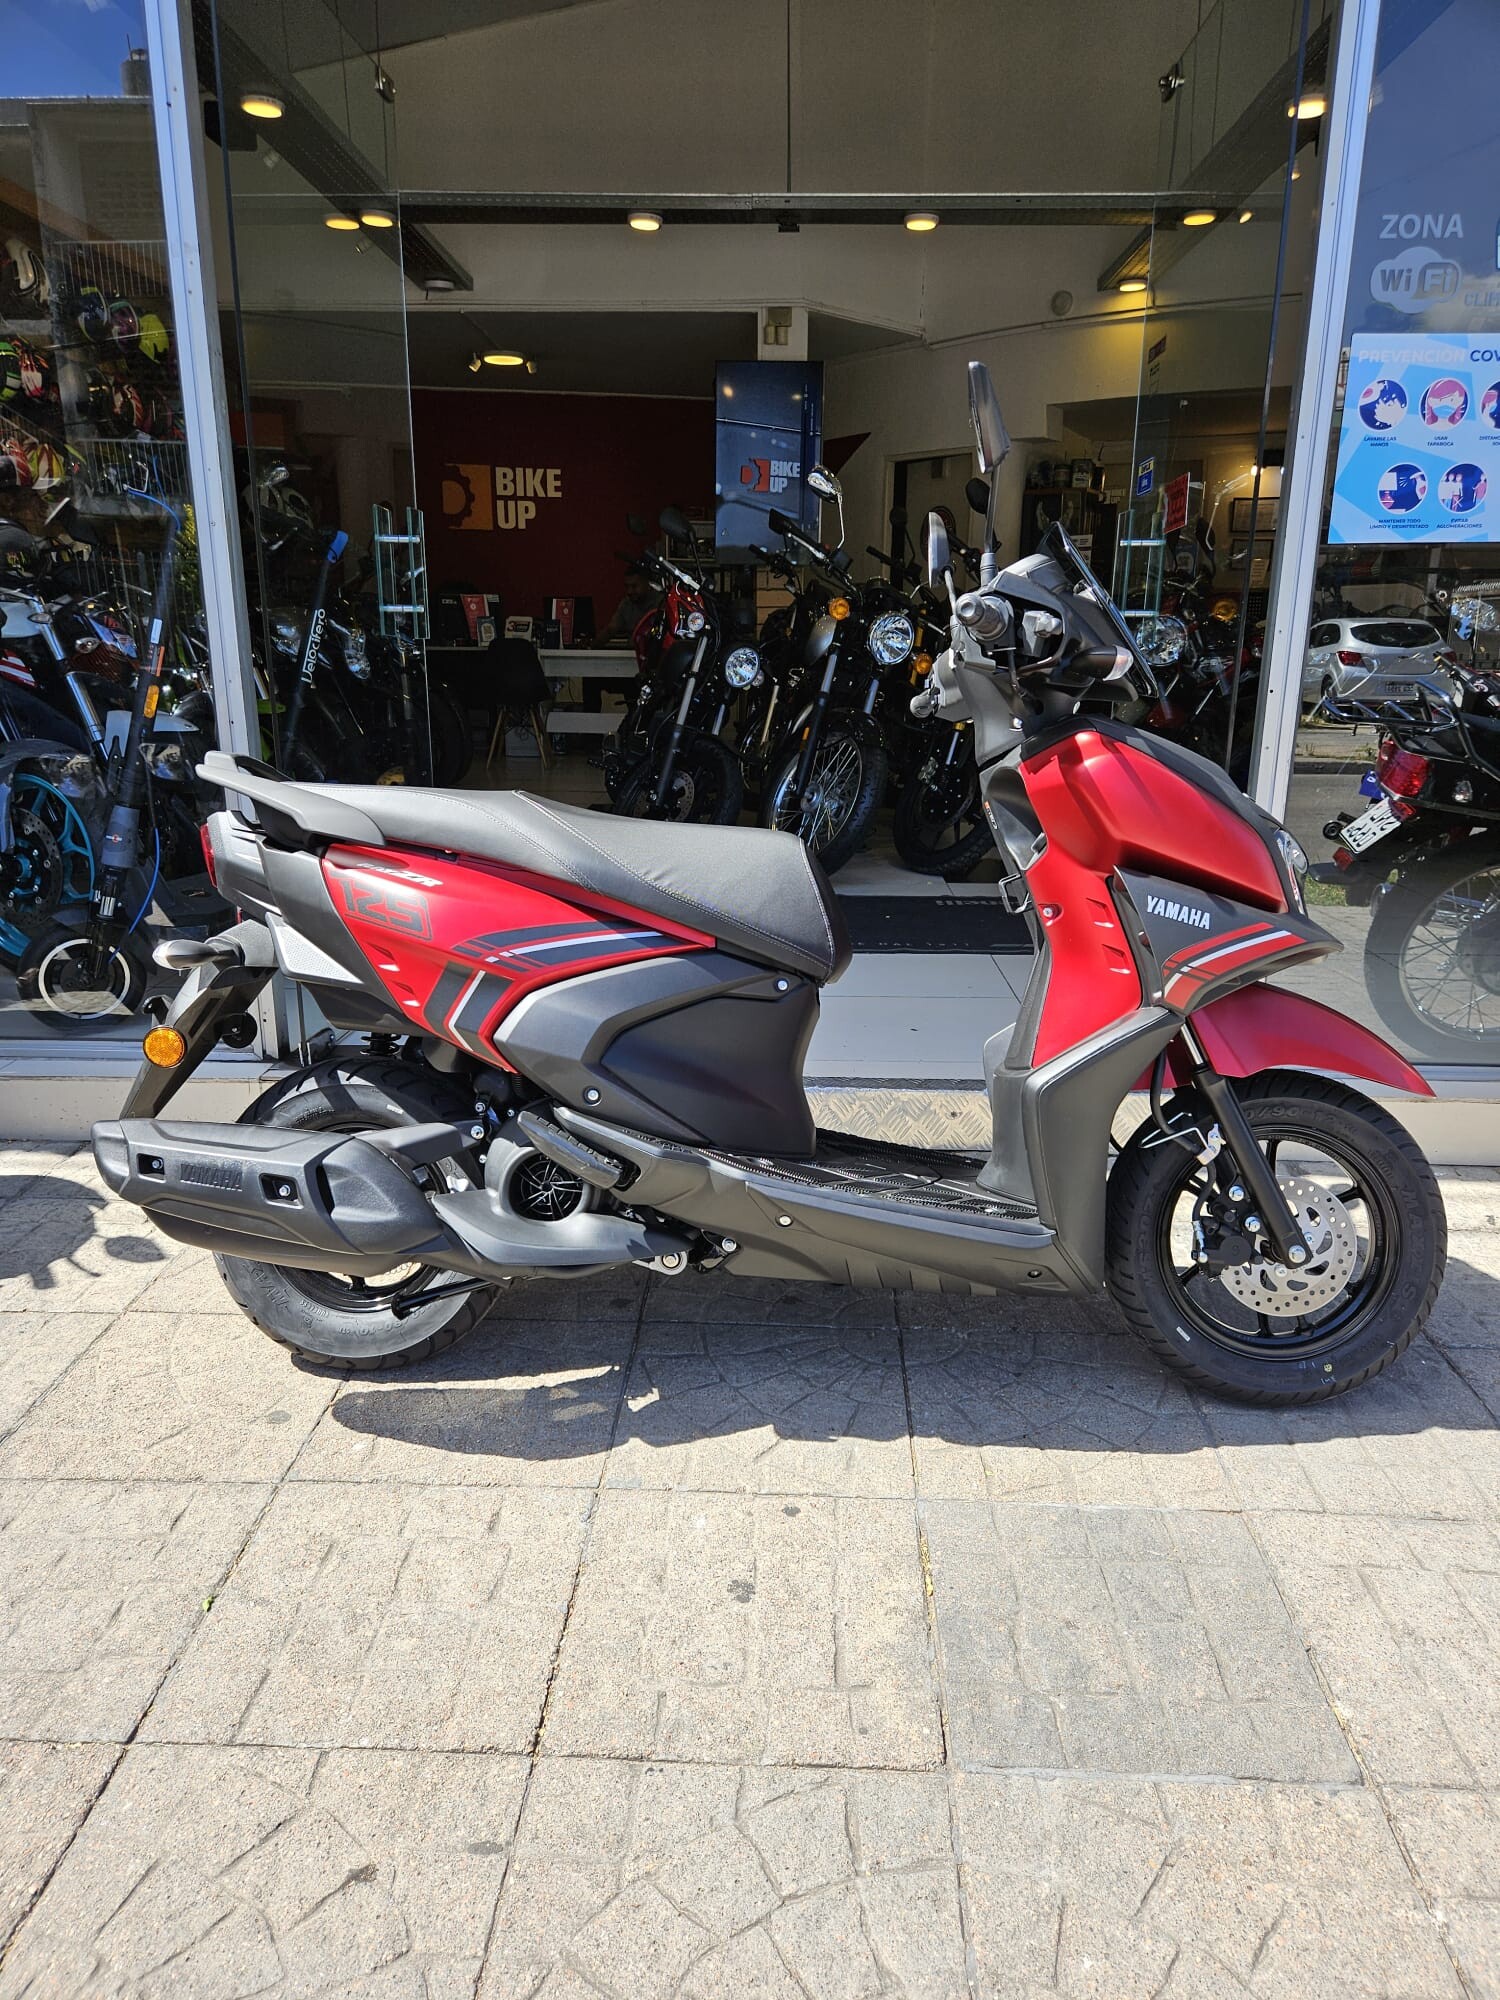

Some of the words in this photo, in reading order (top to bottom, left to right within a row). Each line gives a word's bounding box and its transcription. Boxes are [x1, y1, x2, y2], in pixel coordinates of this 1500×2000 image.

[1379, 213, 1464, 240] ZONA
[495, 466, 563, 498] BIKE
[770, 460, 800, 478] BIKE
[770, 476, 788, 493] UP
[496, 499, 536, 530] UP
[301, 608, 326, 683] Velocifero
[341, 877, 424, 933] 125
[1147, 895, 1211, 930] YAMAHA
[180, 1162, 243, 1191] YAMAHA
